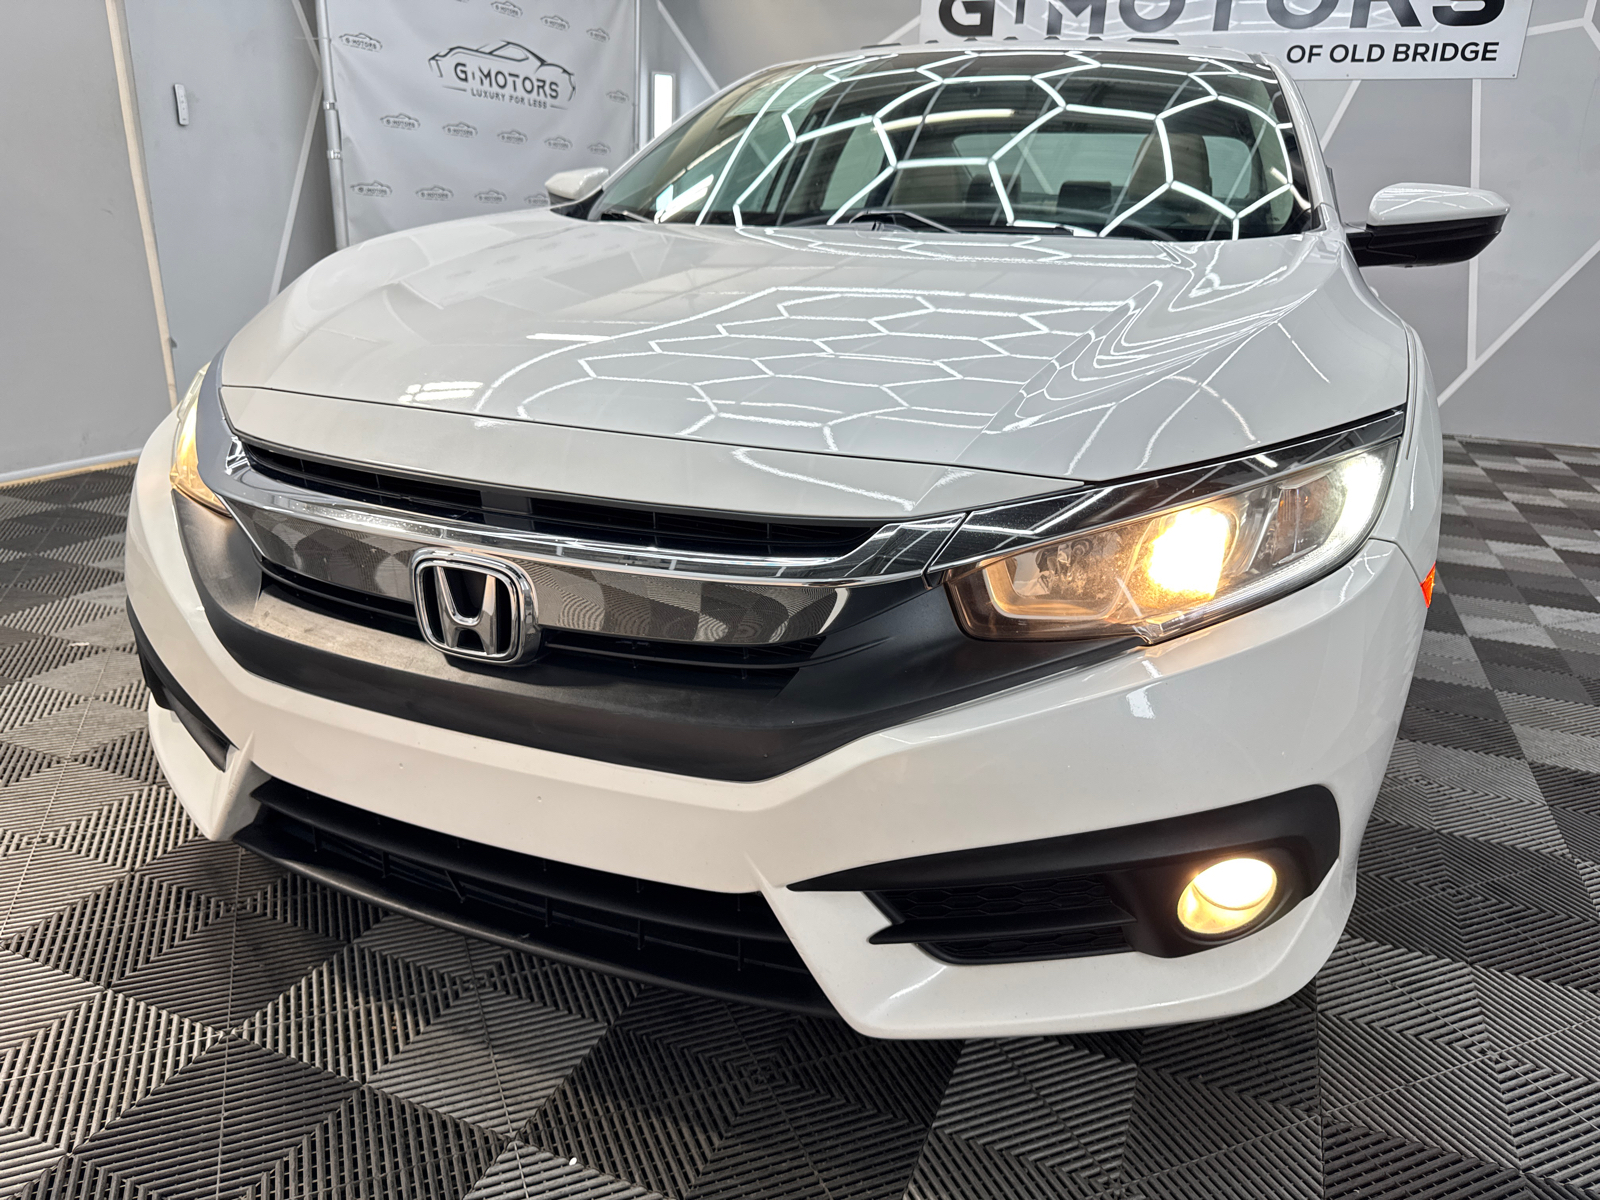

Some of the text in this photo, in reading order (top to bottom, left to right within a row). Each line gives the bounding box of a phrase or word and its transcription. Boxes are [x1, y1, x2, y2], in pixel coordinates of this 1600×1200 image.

[1286, 41, 1499, 63] OF OLD BRIDGE
[454, 62, 560, 100] G MOTORS
[470, 87, 548, 110] LUXURY FOR LESS
